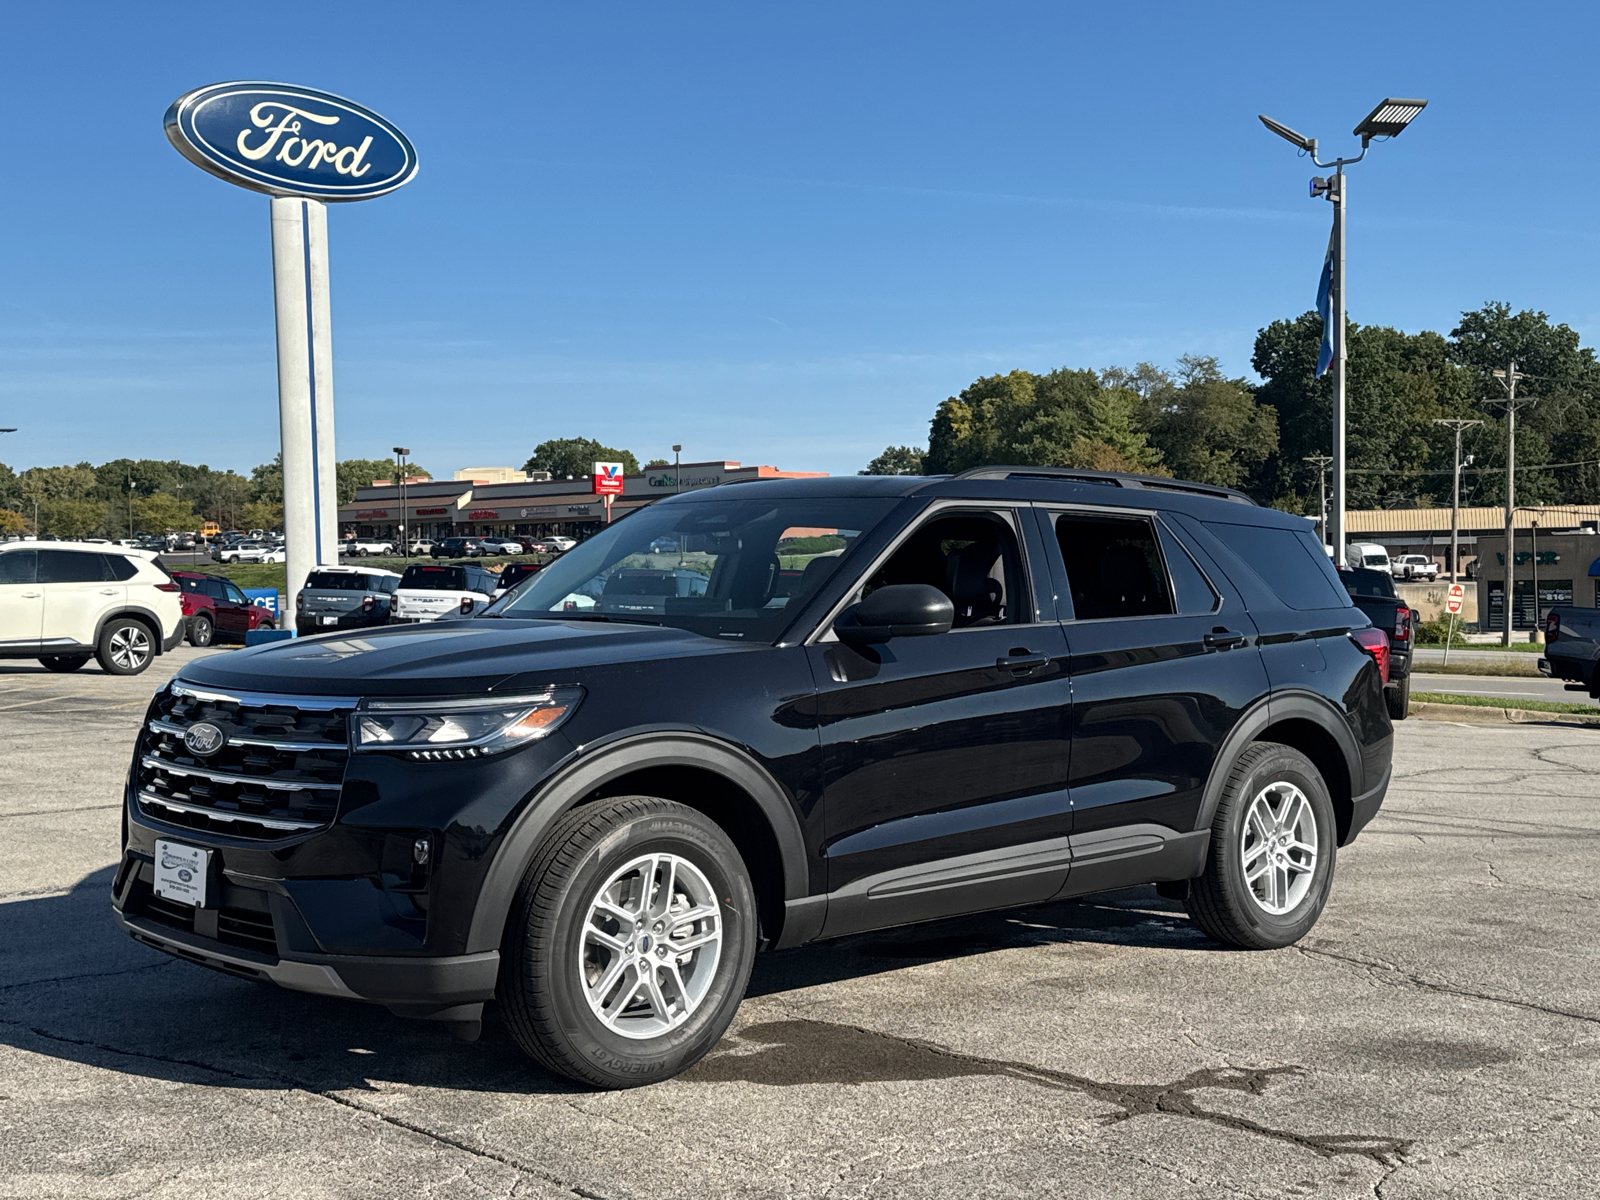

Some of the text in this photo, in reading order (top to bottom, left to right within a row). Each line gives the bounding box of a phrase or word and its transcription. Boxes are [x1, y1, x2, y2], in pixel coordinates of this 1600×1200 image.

[237, 101, 374, 178] Ford
[253, 596, 276, 611] CE
[190, 727, 217, 749] Ford
[590, 1048, 666, 1075] KINERGY GT
